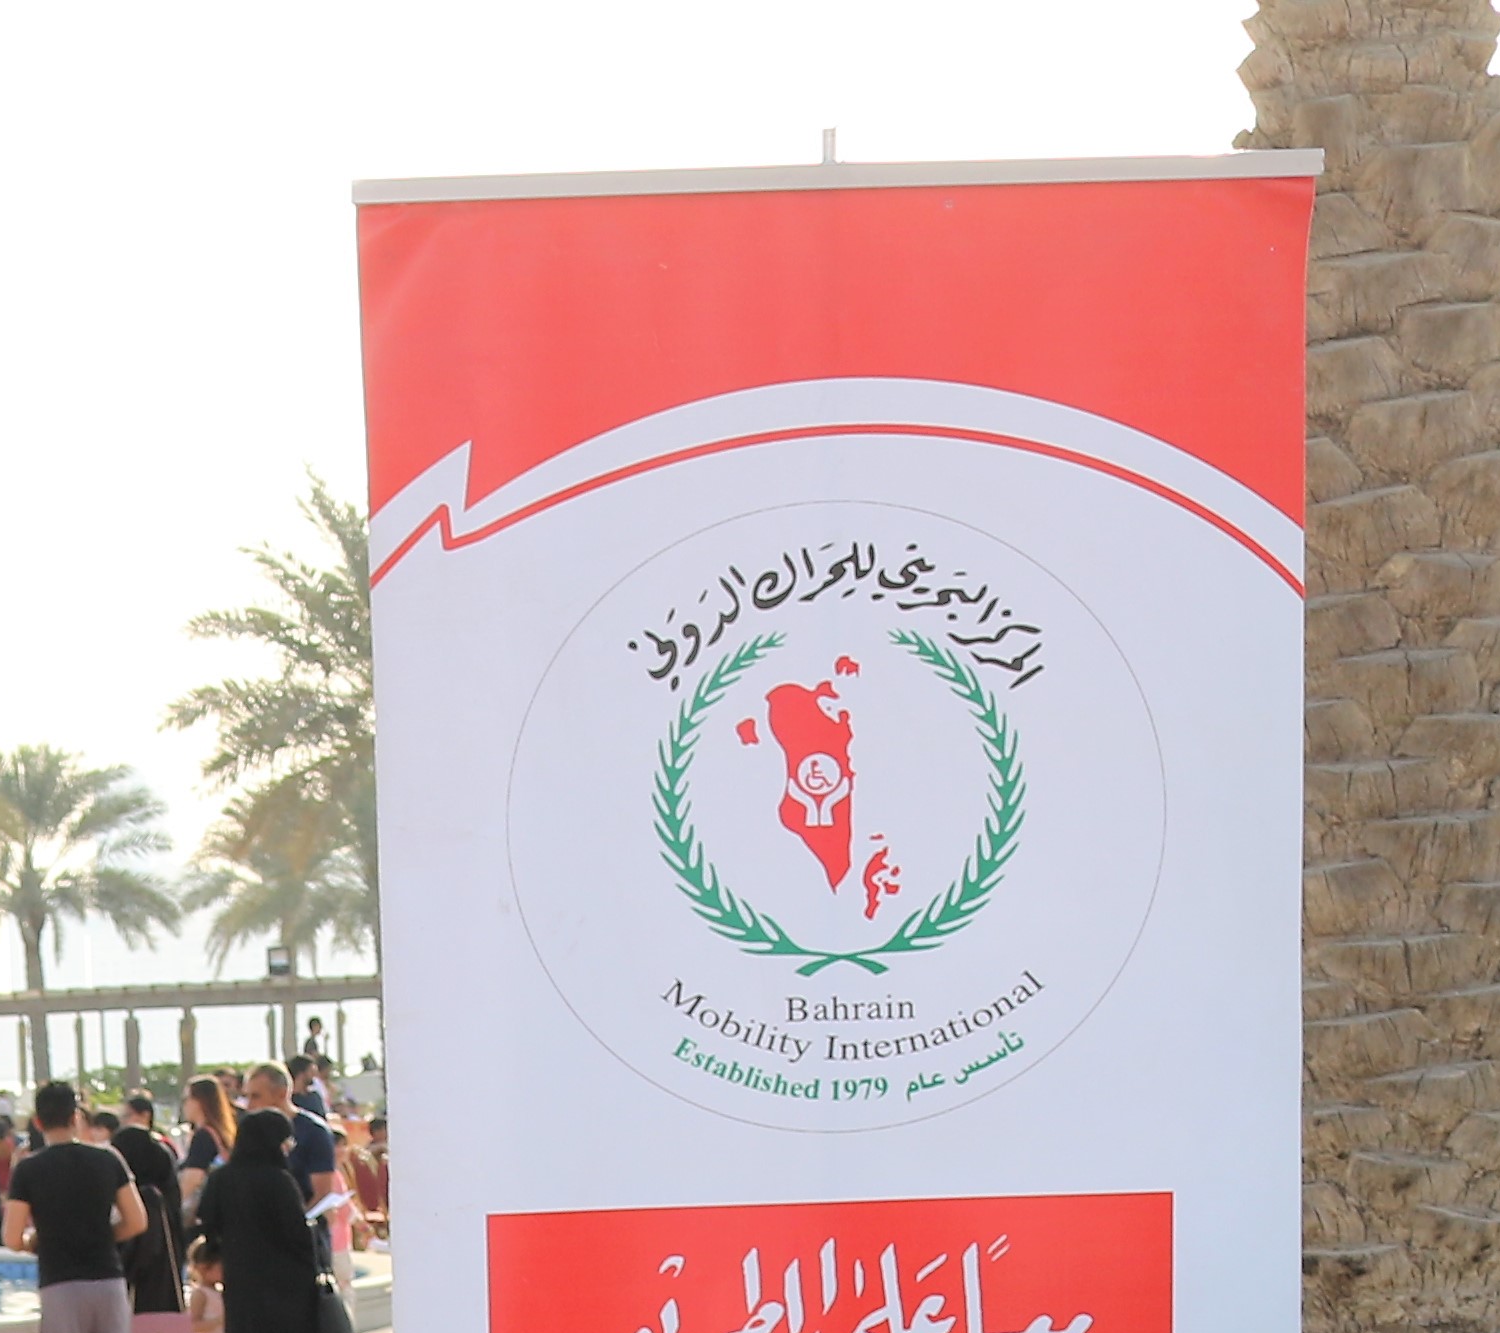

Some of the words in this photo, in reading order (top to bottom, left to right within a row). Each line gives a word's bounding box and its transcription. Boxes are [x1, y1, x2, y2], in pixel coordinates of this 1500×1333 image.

[660, 977, 813, 1064] Mobility
[823, 970, 1047, 1062] International
[785, 995, 915, 1023] Bahrain
[671, 1037, 820, 1101] Established
[831, 1076, 889, 1101] 1979
[953, 1030, 1026, 1086] تأسس
[904, 1072, 946, 1102] عام
